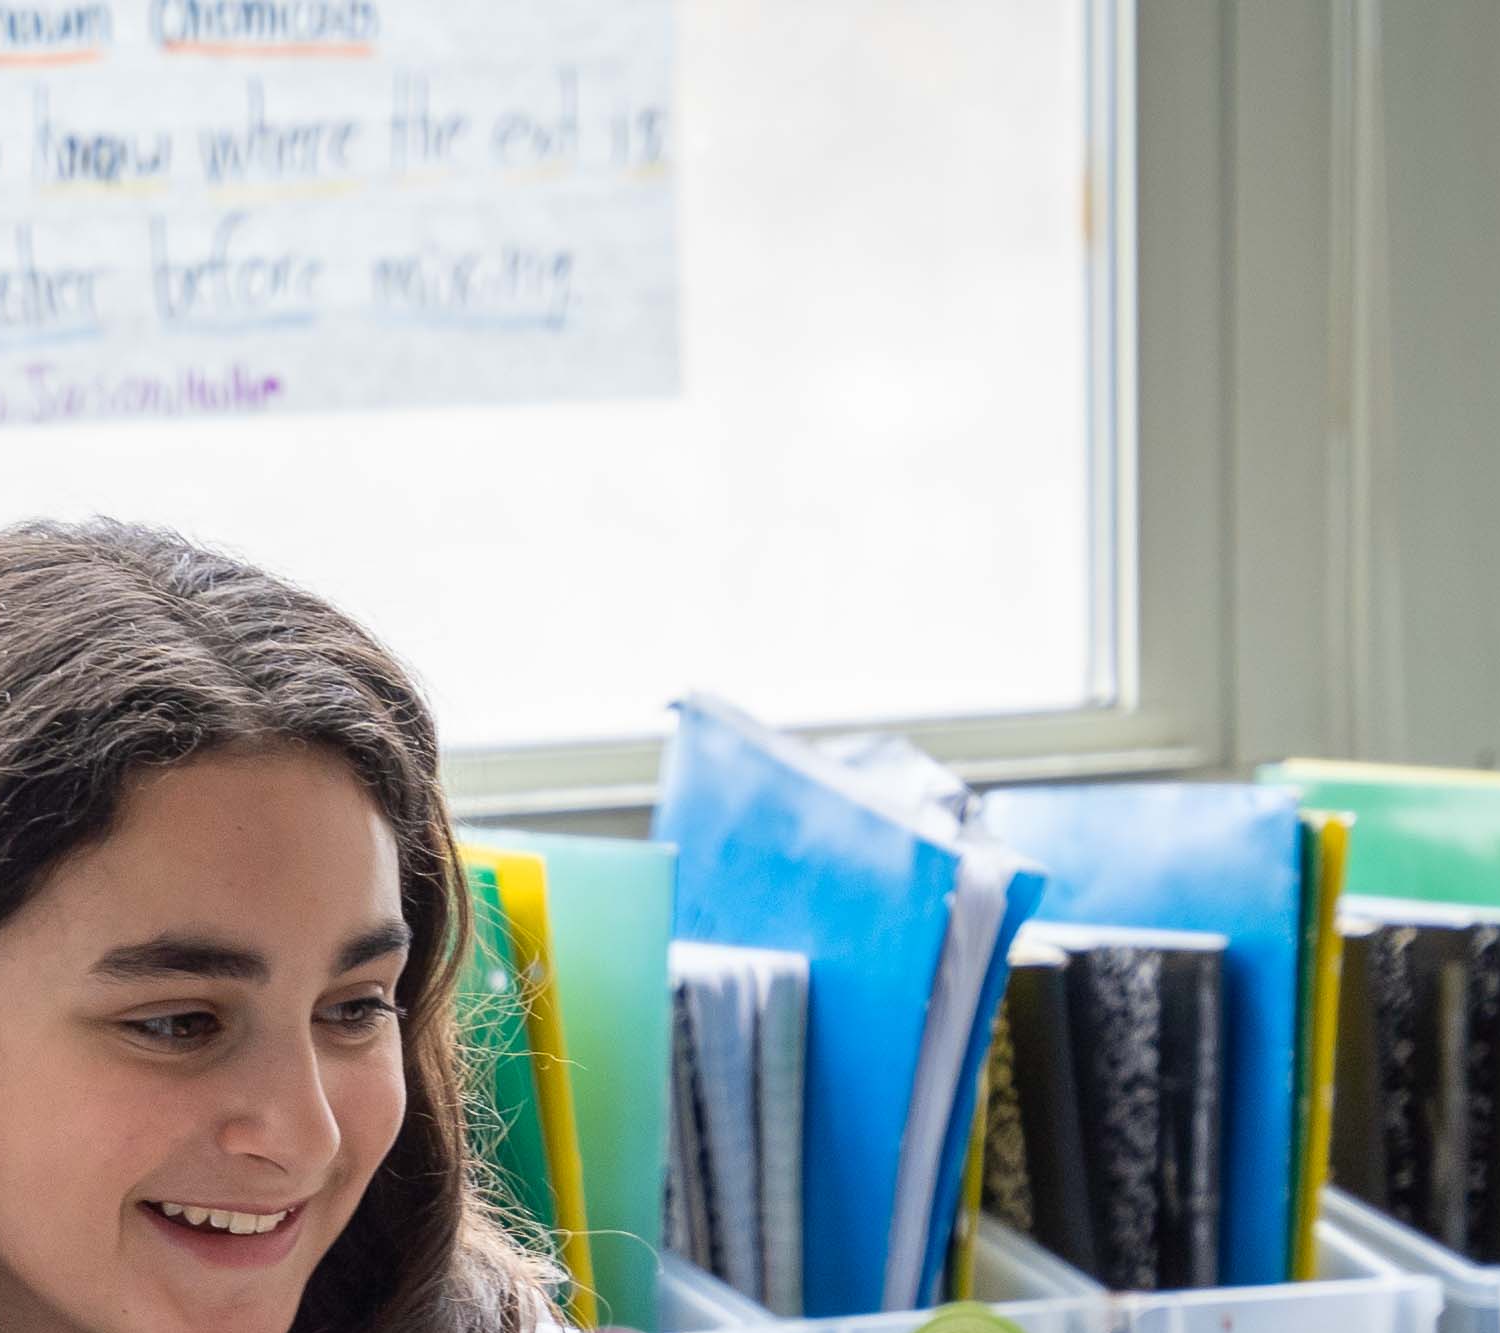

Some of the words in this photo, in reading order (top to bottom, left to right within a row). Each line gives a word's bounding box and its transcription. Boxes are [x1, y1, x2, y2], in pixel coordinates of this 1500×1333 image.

[32, 82, 173, 188] know
[198, 75, 360, 188] where
[389, 68, 470, 178] the
[152, 208, 325, 320] before
